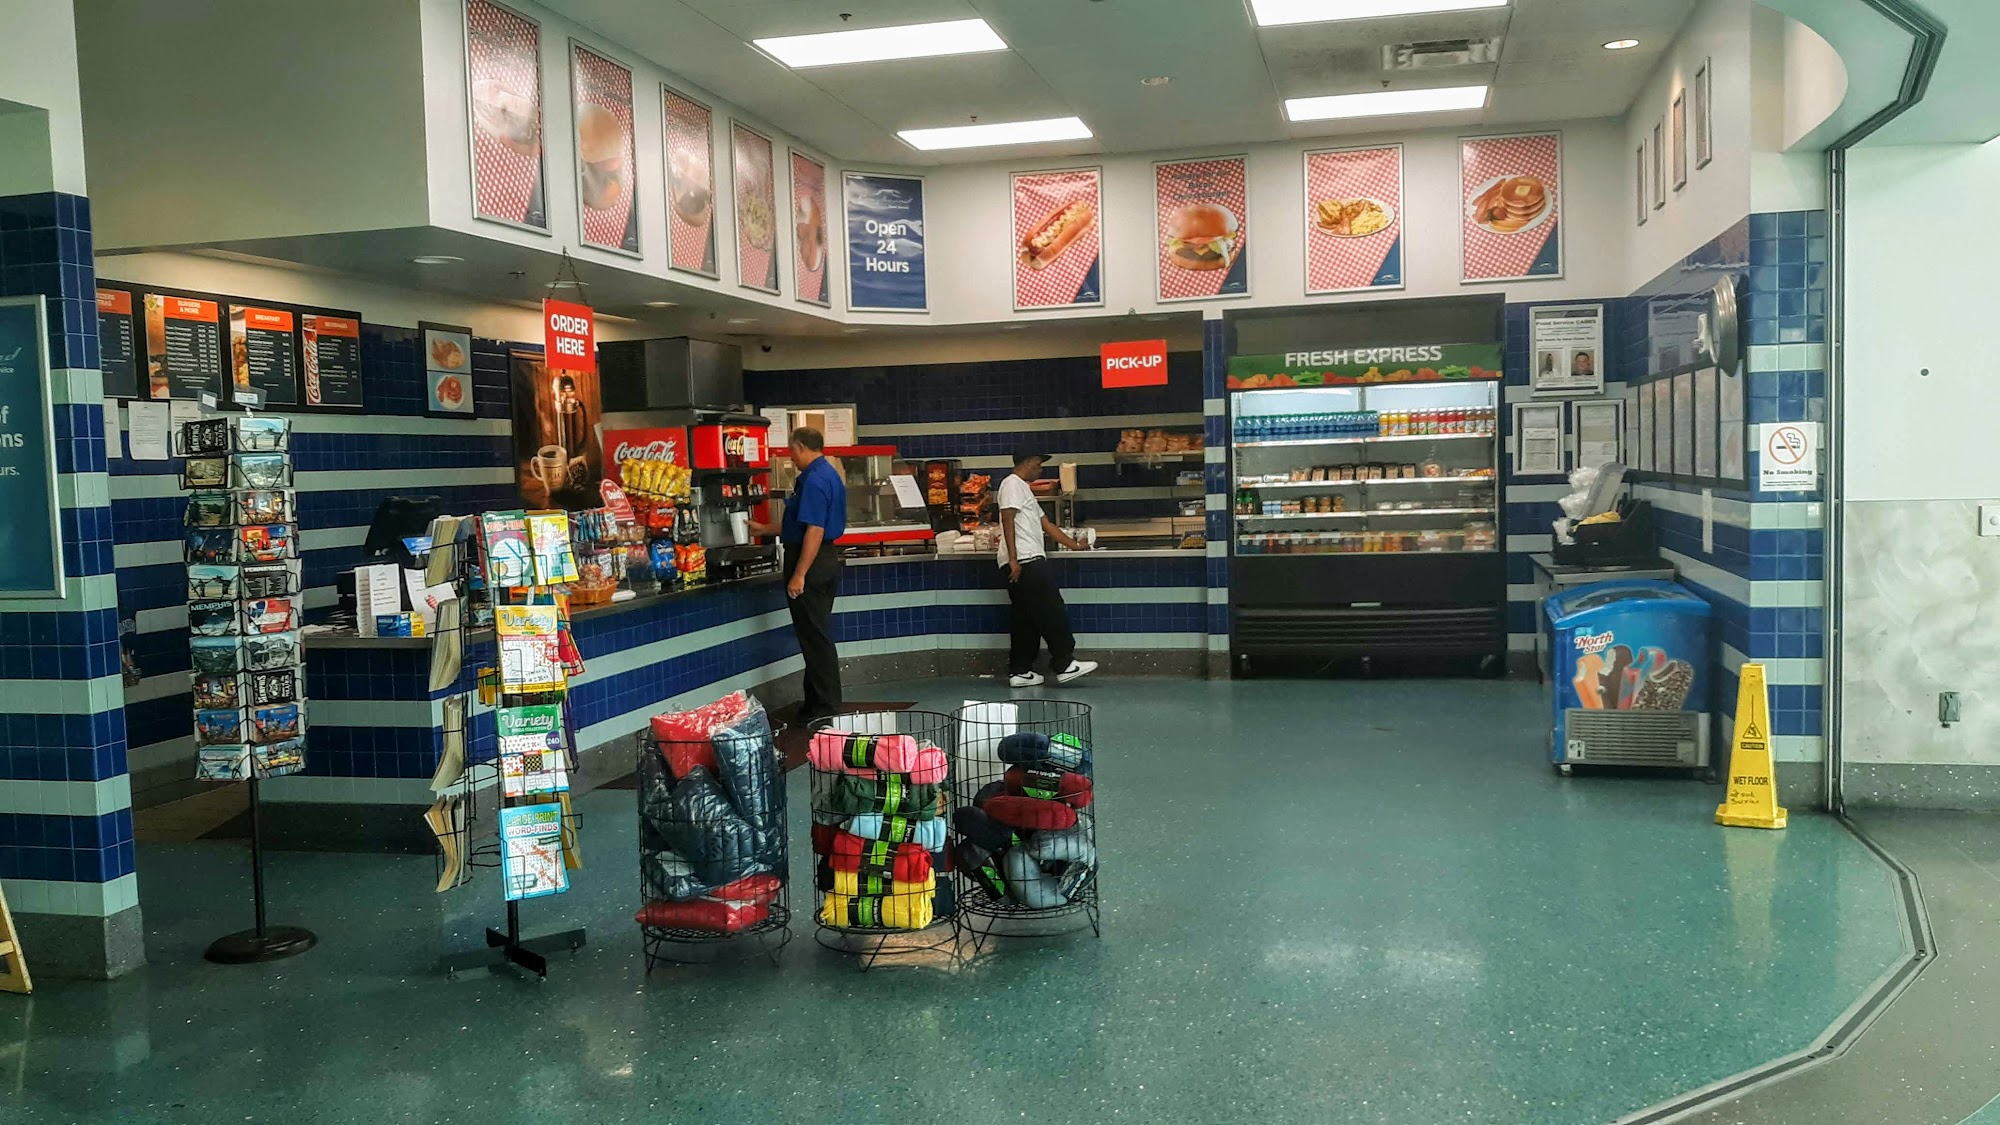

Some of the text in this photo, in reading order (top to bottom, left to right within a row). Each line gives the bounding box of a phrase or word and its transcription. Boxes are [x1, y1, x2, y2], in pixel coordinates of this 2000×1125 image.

[865, 219, 907, 237] Open
[877, 240, 897, 255] 24
[865, 257, 910, 273] Hours
[551, 313, 589, 336] ORDER
[556, 335, 586, 357] HERE
[1106, 355, 1162, 370] PICK-UP
[1285, 345, 1442, 368] FRESH EXPRESS
[1776, 468, 1813, 476] Smoking
[190, 600, 232, 611] MEMPHIS
[502, 612, 553, 632] Variety
[1575, 632, 1612, 648] North
[1586, 643, 1606, 653] Star
[502, 713, 554, 731] Variety
[546, 737, 560, 745] 240
[1733, 776, 1769, 786] WET FLOOR
[506, 811, 559, 827] LARGE PRINT
[508, 823, 558, 836] WORD-FINDS
